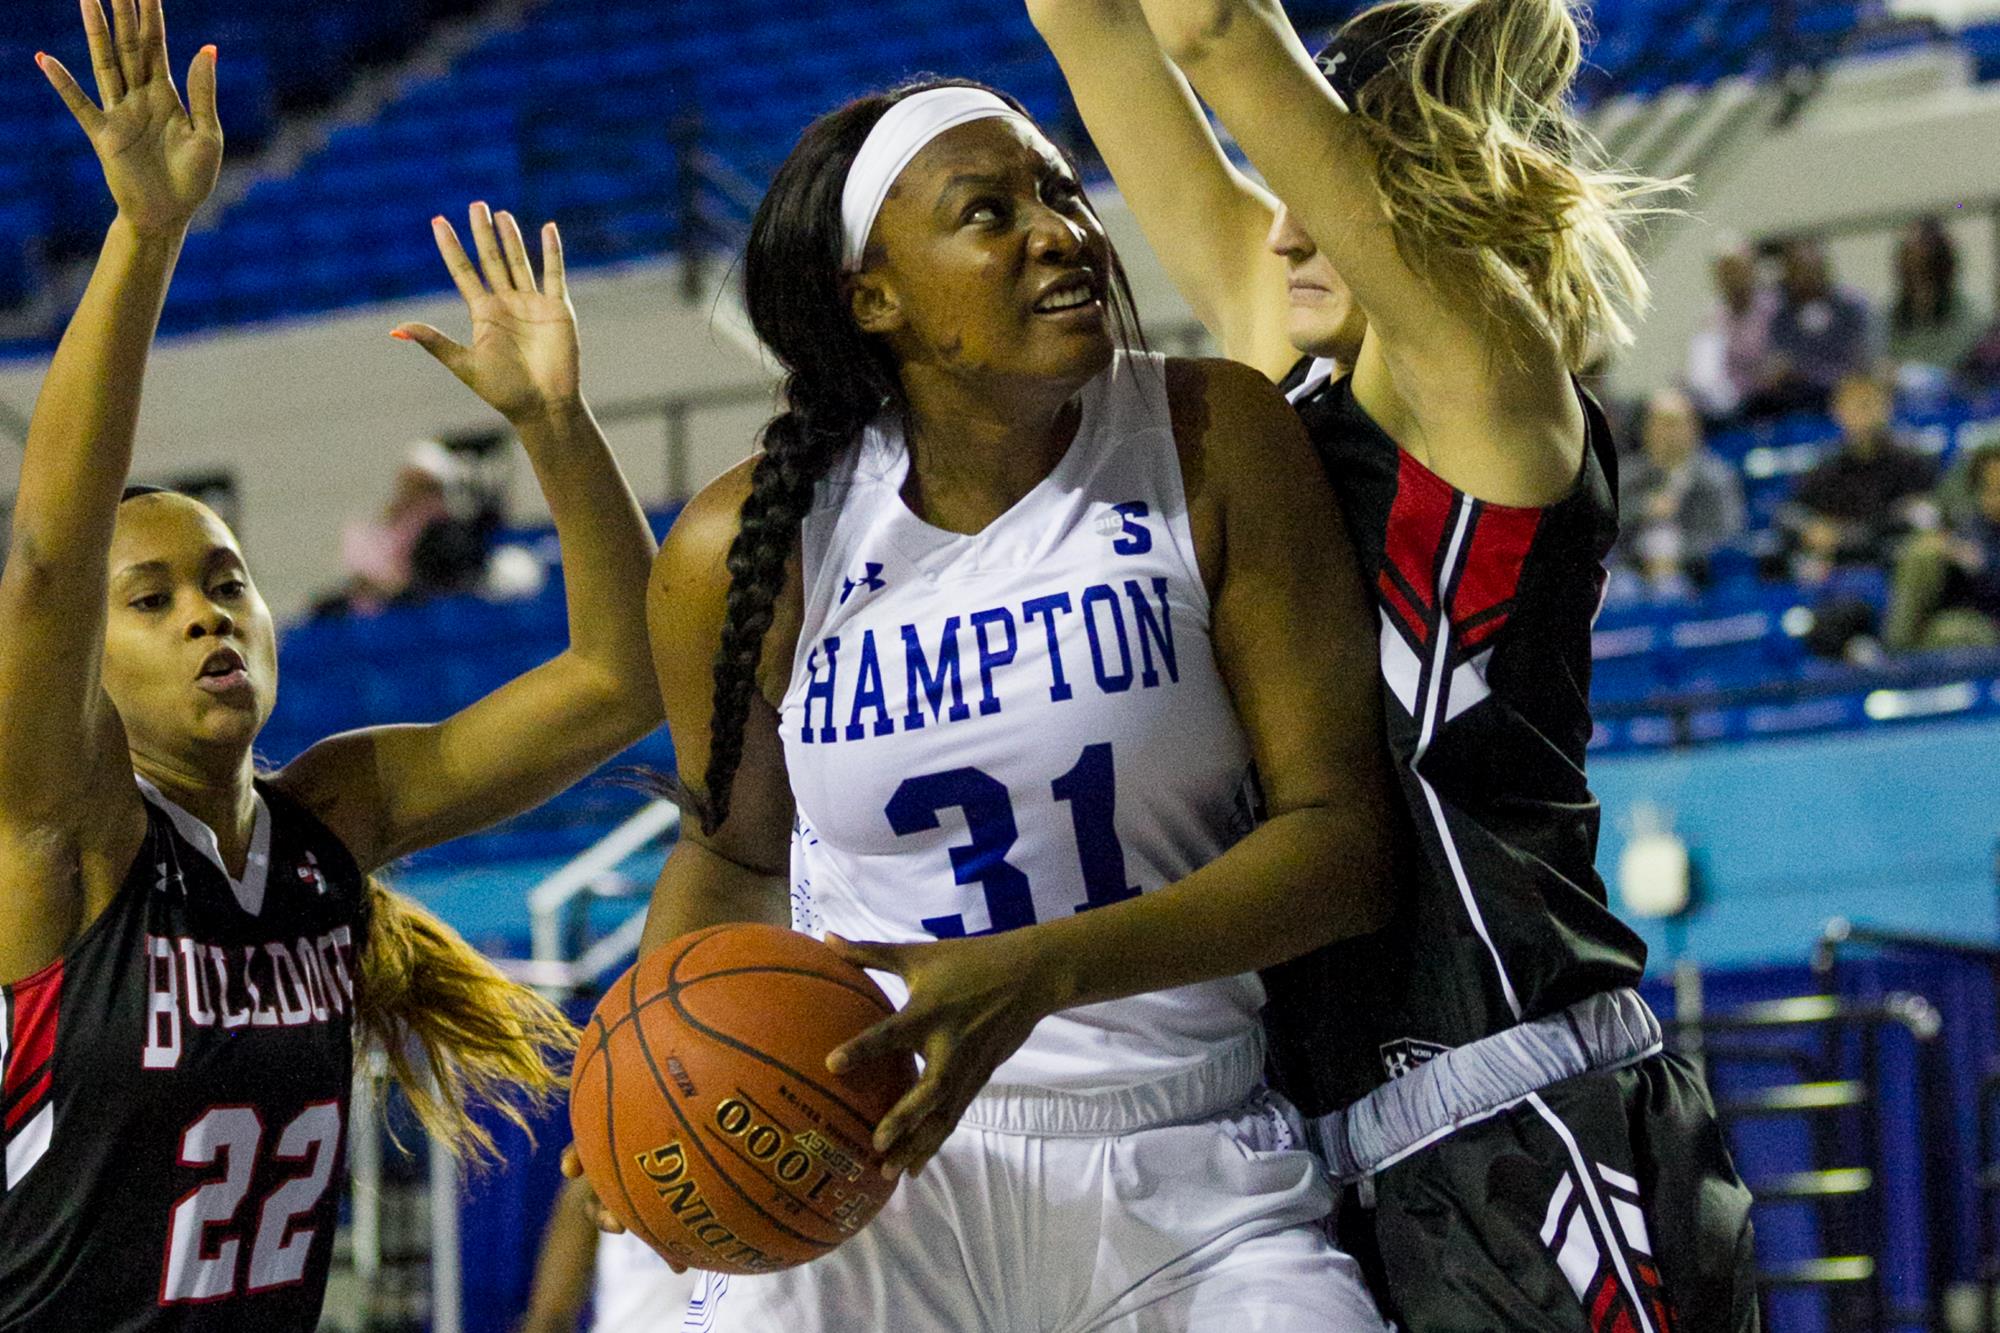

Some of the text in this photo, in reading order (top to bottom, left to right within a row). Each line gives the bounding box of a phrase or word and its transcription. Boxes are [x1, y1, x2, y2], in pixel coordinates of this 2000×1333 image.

[1110, 500, 1153, 556] S
[801, 577, 1179, 744] HAMPTON
[884, 741, 1143, 938] 31
[157, 1100, 343, 1307] 22
